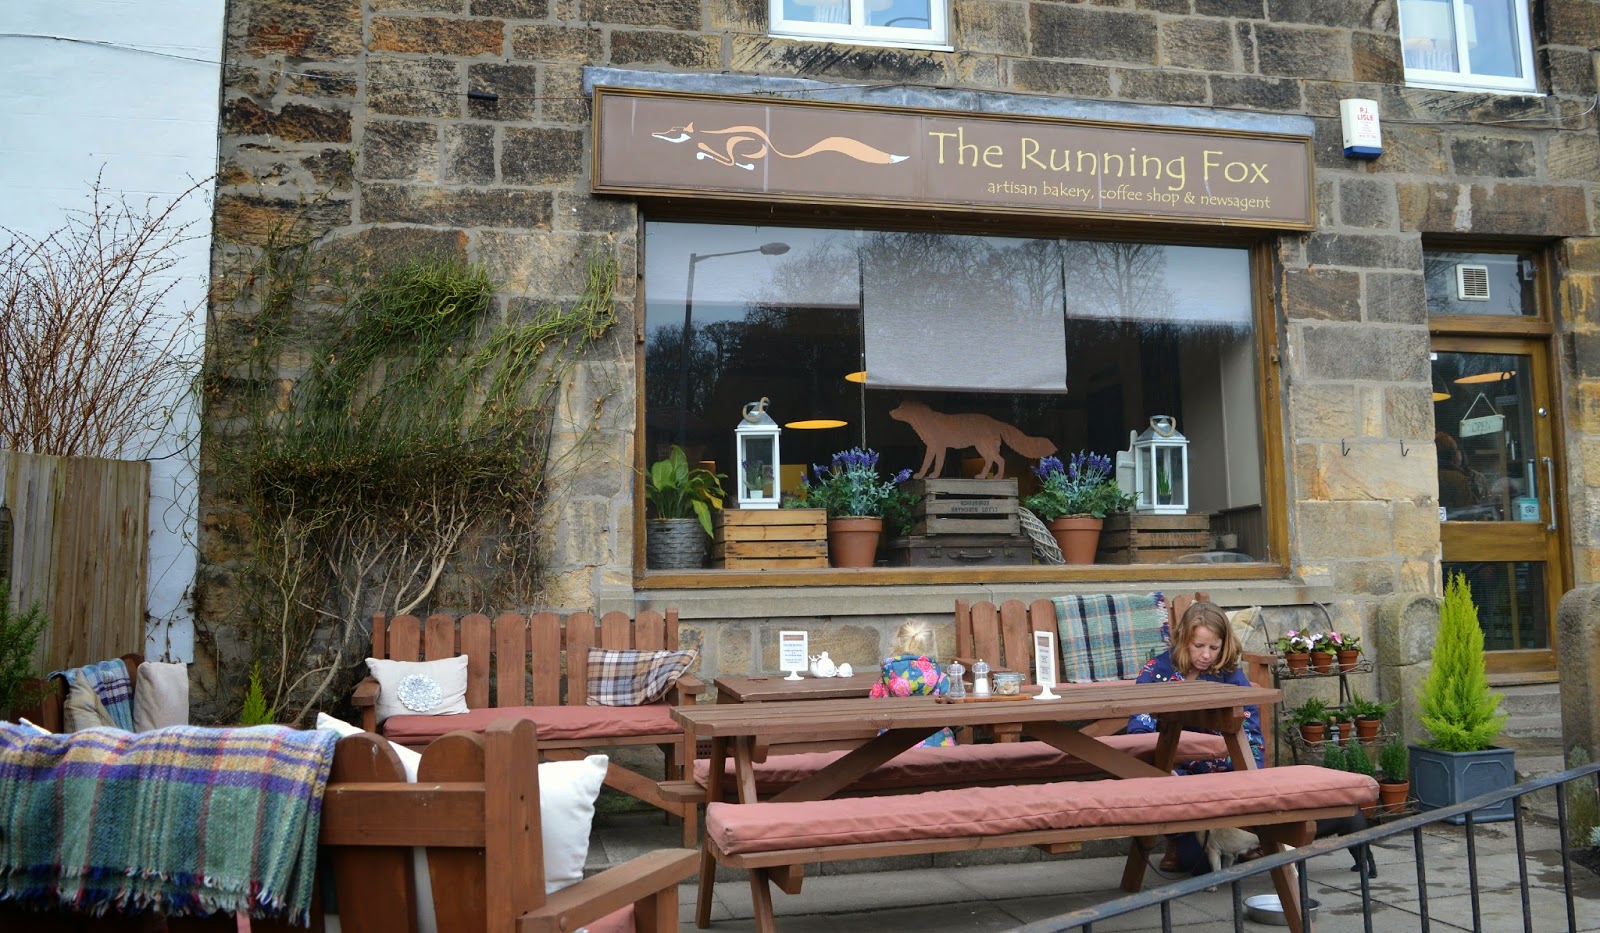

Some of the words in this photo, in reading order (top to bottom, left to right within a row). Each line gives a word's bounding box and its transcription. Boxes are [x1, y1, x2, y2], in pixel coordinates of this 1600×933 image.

[928, 127, 1004, 169] The
[1020, 137, 1187, 192] Running
[1202, 149, 1271, 185] Fox
[987, 180, 1038, 196] artisan
[1043, 180, 1095, 202] bakery,
[1099, 184, 1143, 201] coffee
[1146, 187, 1180, 207] shop
[1184, 191, 1196, 205] &
[1200, 194, 1271, 212] newsagent
